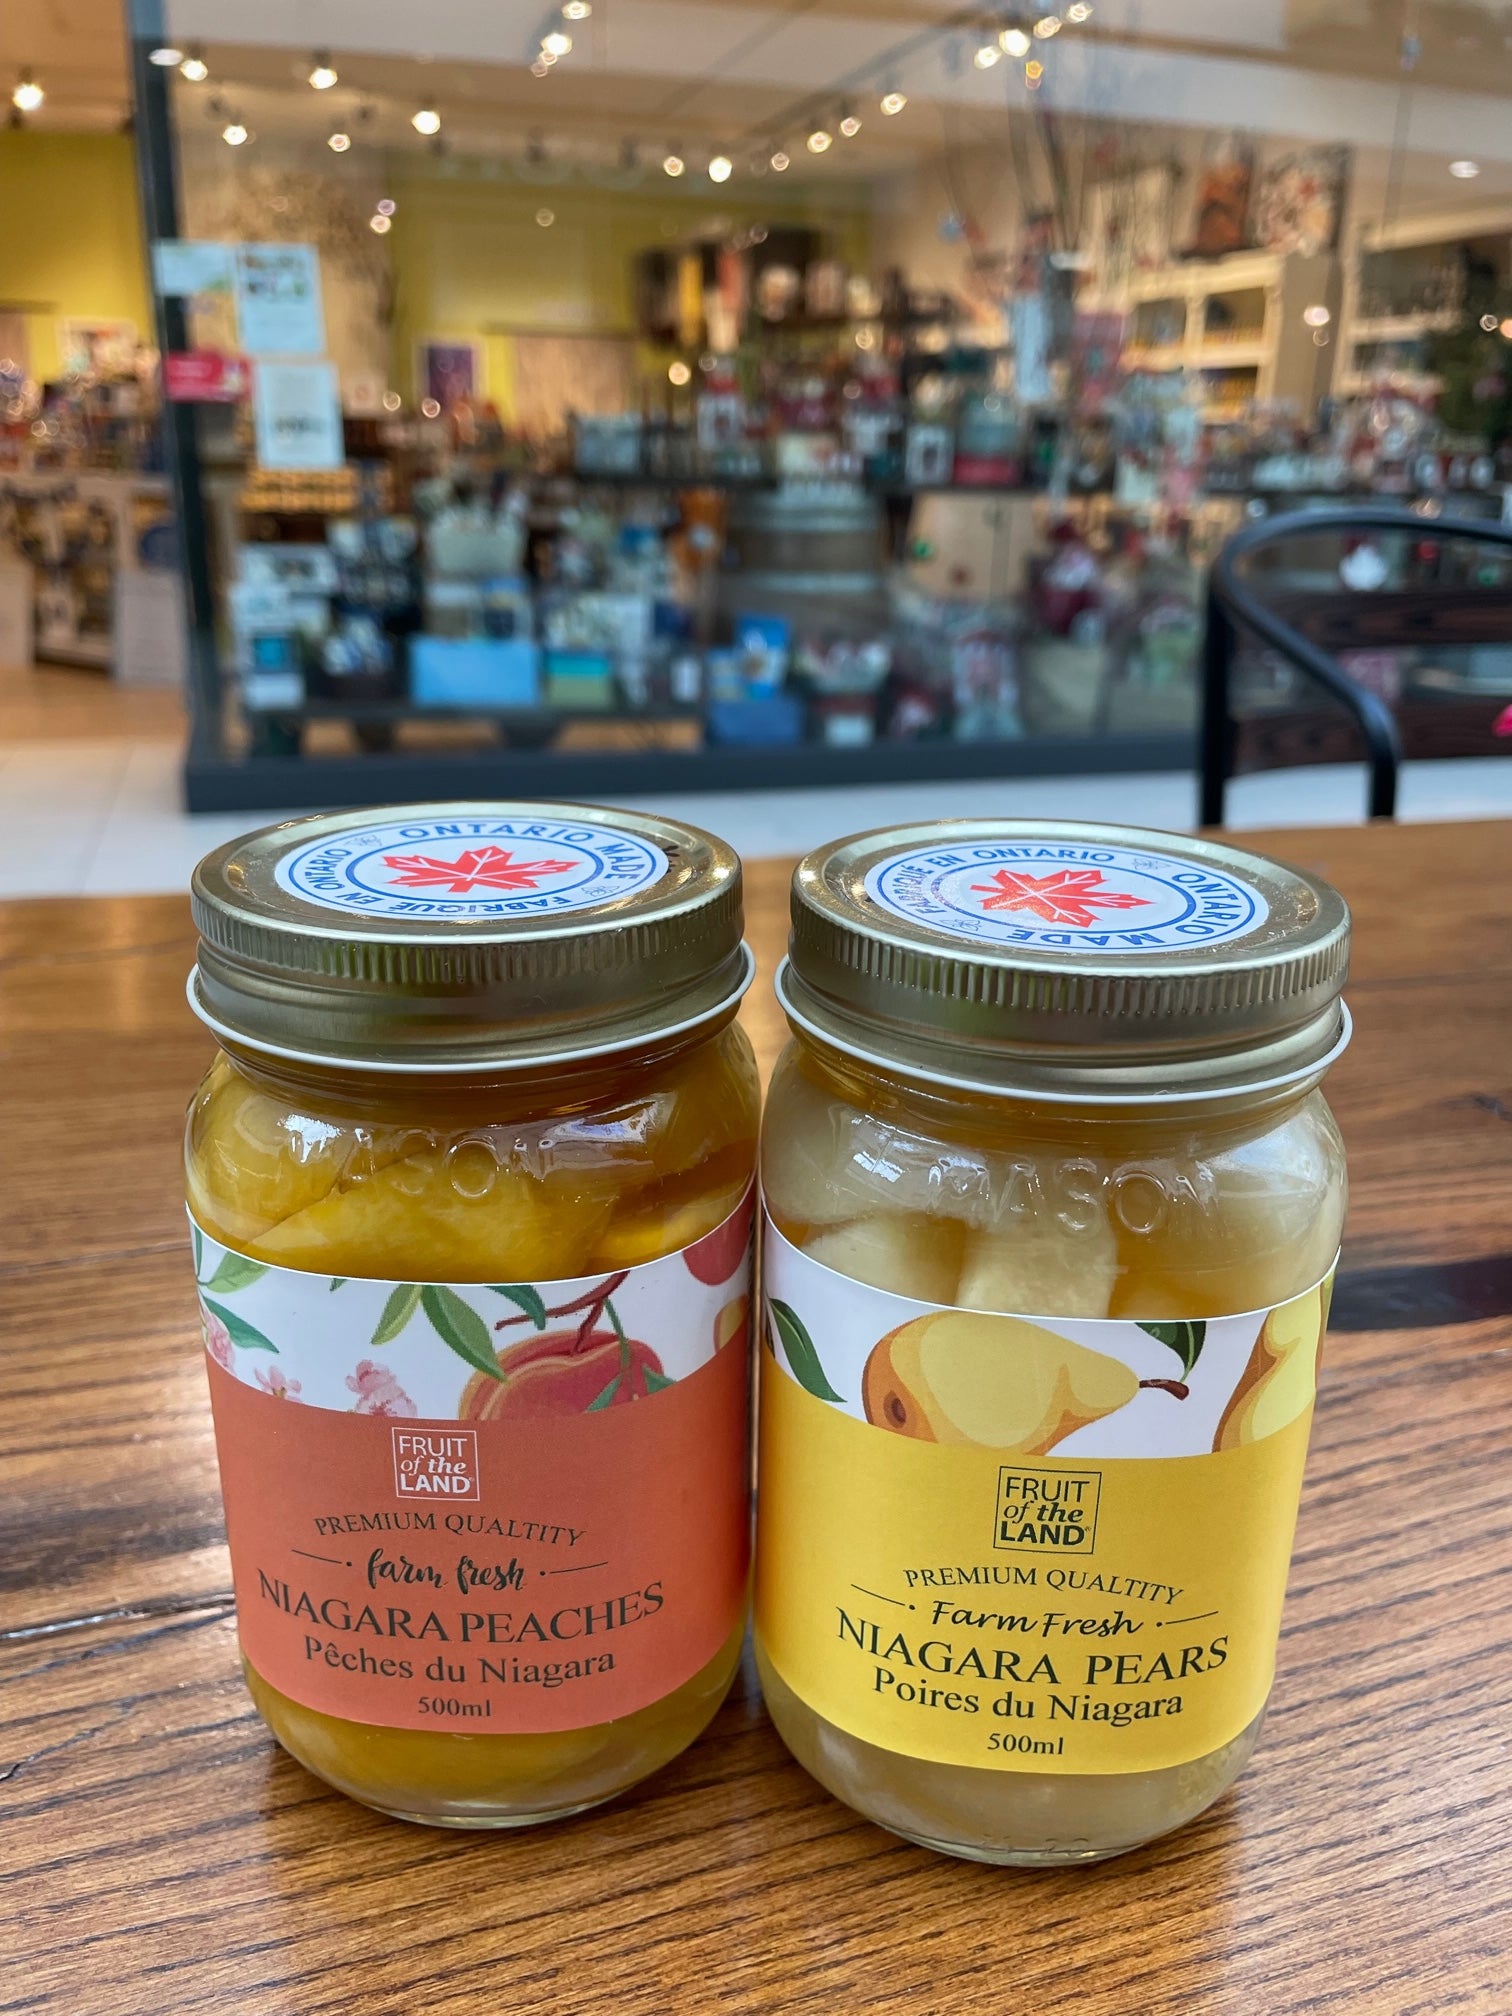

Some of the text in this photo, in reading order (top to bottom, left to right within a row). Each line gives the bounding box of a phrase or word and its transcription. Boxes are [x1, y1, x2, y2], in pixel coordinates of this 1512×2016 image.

[304, 848, 353, 891] ONTARIO
[400, 823, 595, 842] ONTARIO
[595, 842, 646, 880] MADE
[923, 853, 968, 867] EN
[972, 848, 1115, 863] ONTARIO
[335, 892, 385, 905] EN
[1005, 873, 1242, 945] ONTARIO MADE
[399, 1435, 468, 1457] FRUIT
[400, 1455, 467, 1476] of the
[1006, 1476, 1090, 1502] FRUIT
[315, 1513, 586, 1547] PREMIUM QUALTITY
[1003, 1500, 1084, 1524] of the
[368, 1548, 525, 1594] farm fresh
[904, 1567, 1184, 1605] PREMIUM QUALTITY
[257, 1569, 665, 1643] NIAGARA PEACHES
[932, 1601, 1144, 1638] Farm Fresh
[305, 1635, 616, 1687] Pêches du Niagara
[836, 1607, 1229, 1685] NIAGARA PEARS
[418, 1697, 491, 1717] 500ml
[873, 1665, 1184, 1728] Poires du Niagara
[987, 1734, 1064, 1756] 500ml
